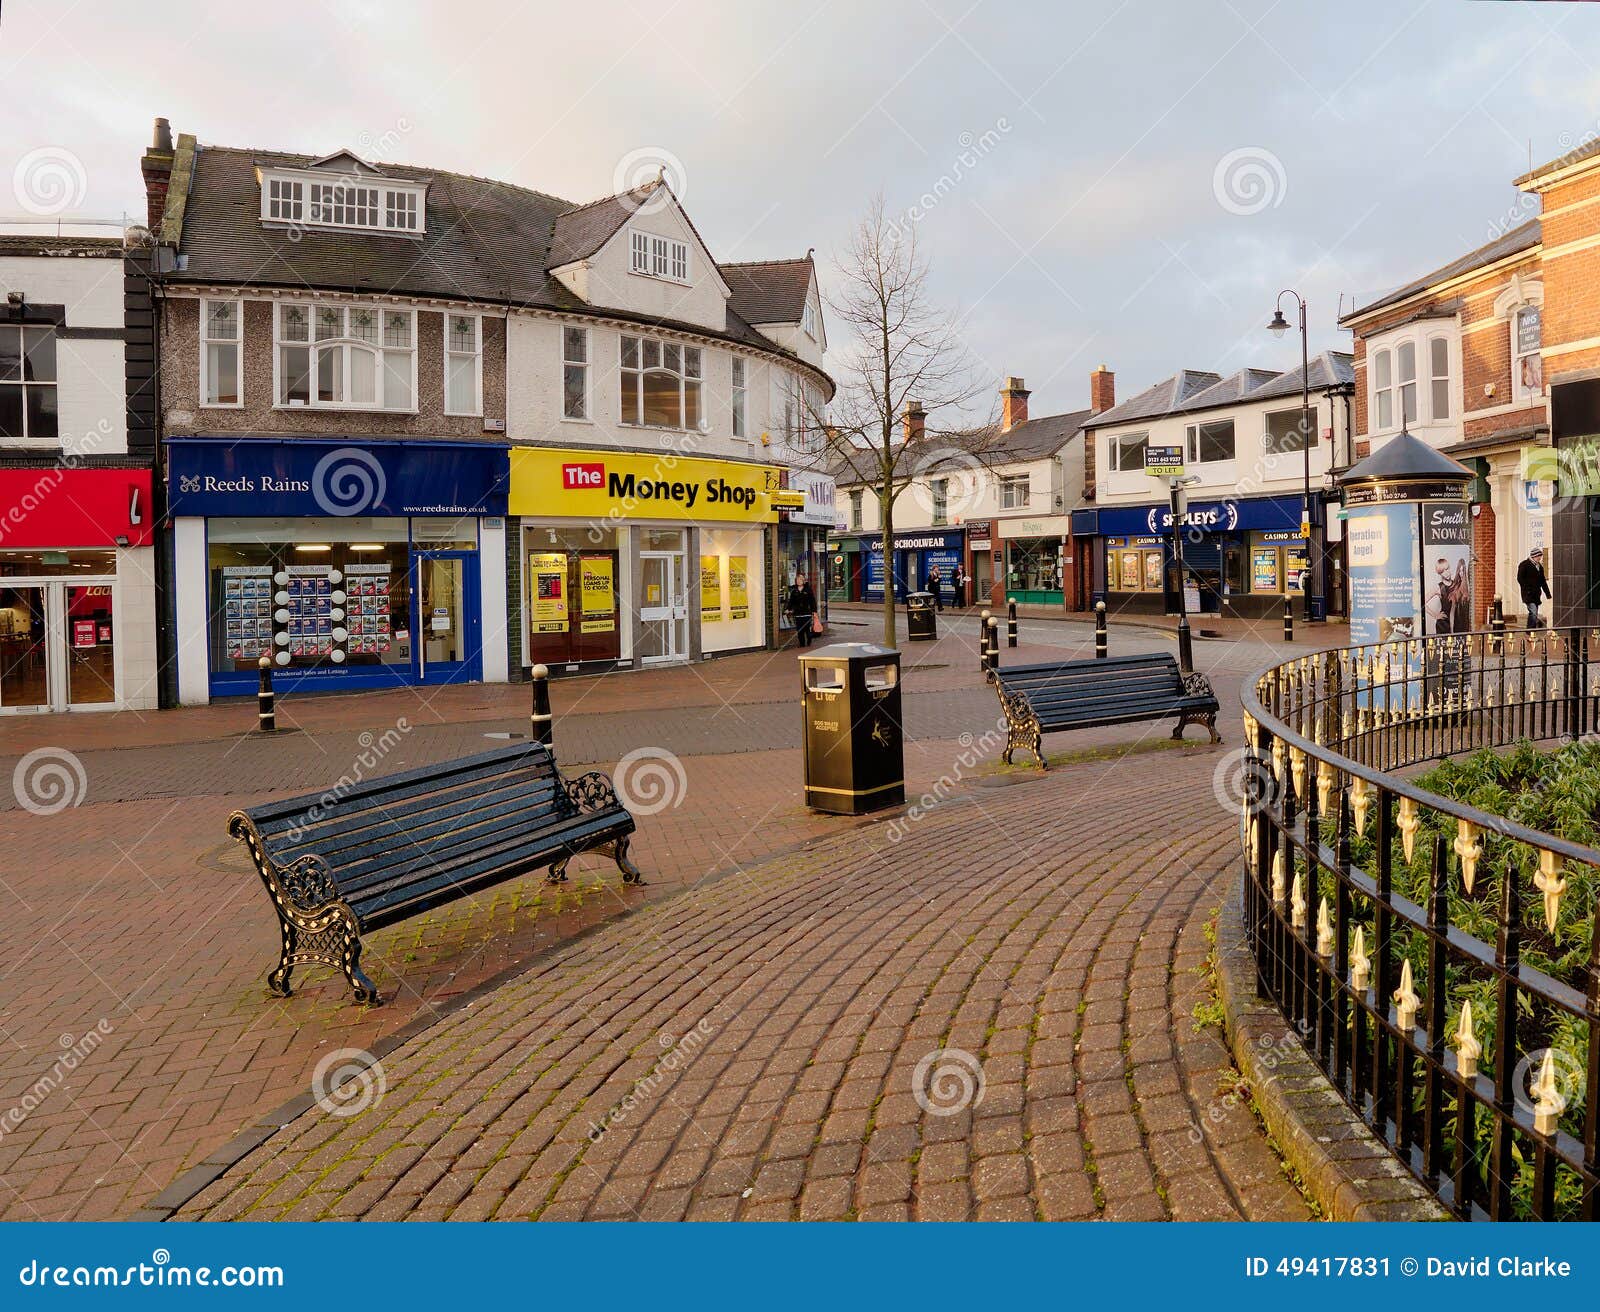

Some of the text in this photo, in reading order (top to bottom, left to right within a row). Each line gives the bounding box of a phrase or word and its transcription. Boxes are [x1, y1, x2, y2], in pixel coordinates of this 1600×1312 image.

[205, 476, 309, 491] Reeds Rains
[566, 467, 756, 510] The Money Shop
[403, 504, 487, 514] www.reedsrains.co.uk
[1163, 511, 1216, 527] SHPLEYS
[1430, 510, 1464, 525] Smith
[1432, 528, 1456, 540] NOW
[872, 537, 944, 549] Cres SCHOOLWEAR
